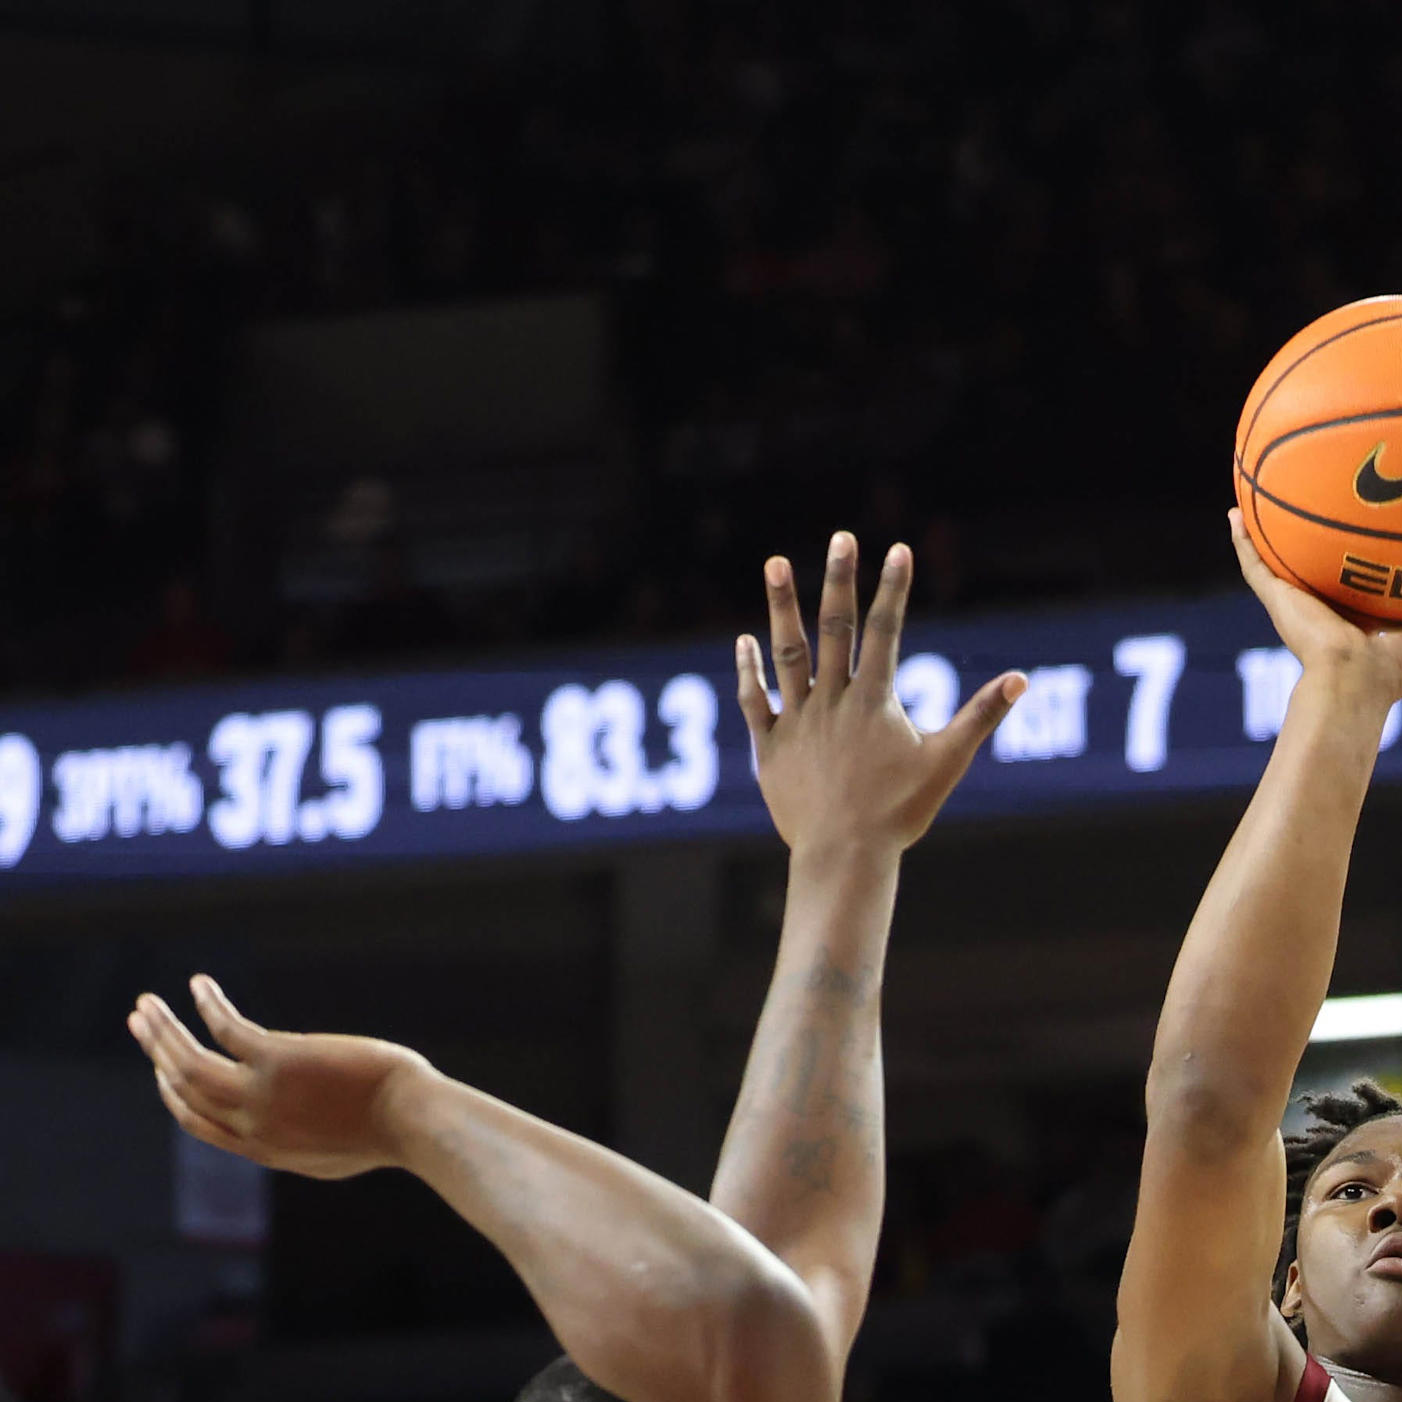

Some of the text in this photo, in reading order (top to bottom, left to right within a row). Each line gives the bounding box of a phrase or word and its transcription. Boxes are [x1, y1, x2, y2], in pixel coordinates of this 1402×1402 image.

[207, 702, 386, 849] 37.5
[540, 672, 720, 822] 83.3
[1112, 633, 1188, 773] 7
